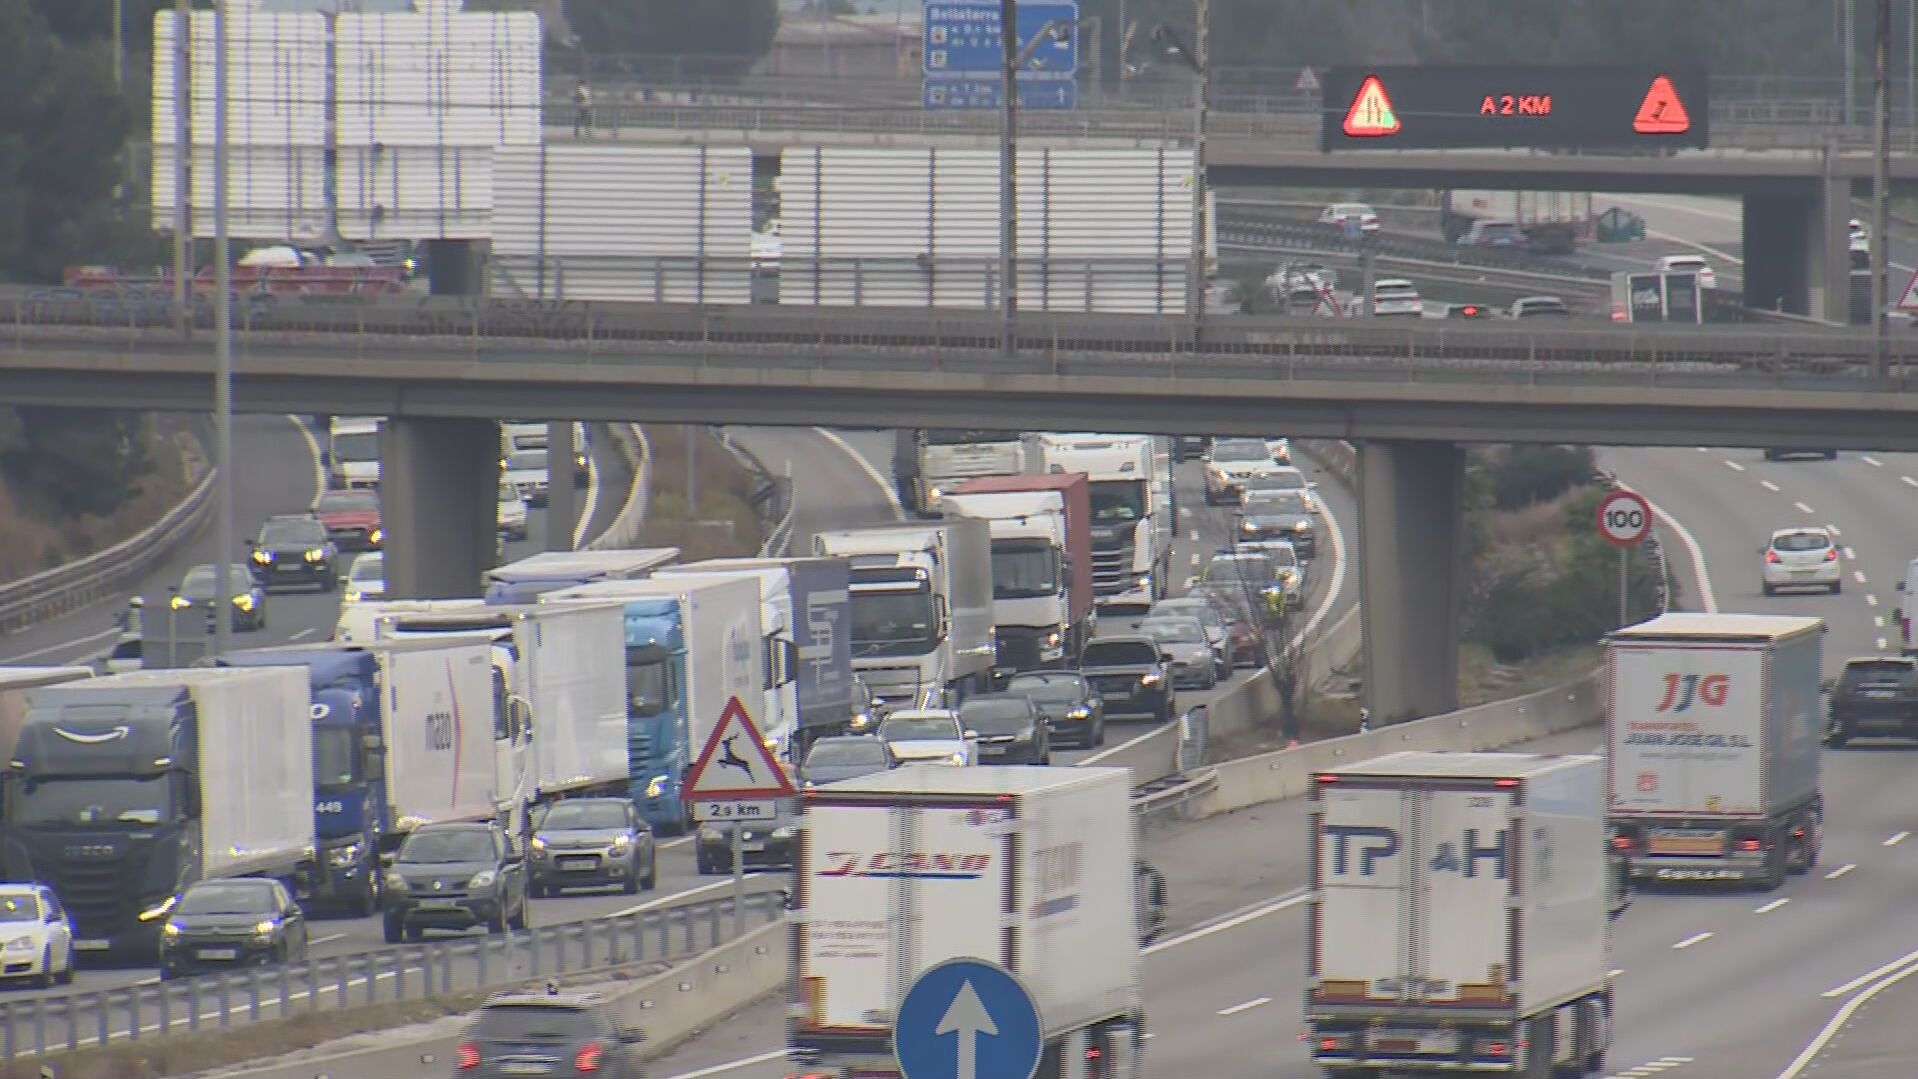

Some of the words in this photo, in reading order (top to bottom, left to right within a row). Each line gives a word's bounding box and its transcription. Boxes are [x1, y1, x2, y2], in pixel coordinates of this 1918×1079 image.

[1480, 95, 1497, 115] A
[1501, 95, 1514, 115] 2
[1518, 95, 1552, 115] KM
[1605, 510, 1643, 528] 100
[1656, 673, 1732, 713] JJG
[737, 803, 761, 816] km
